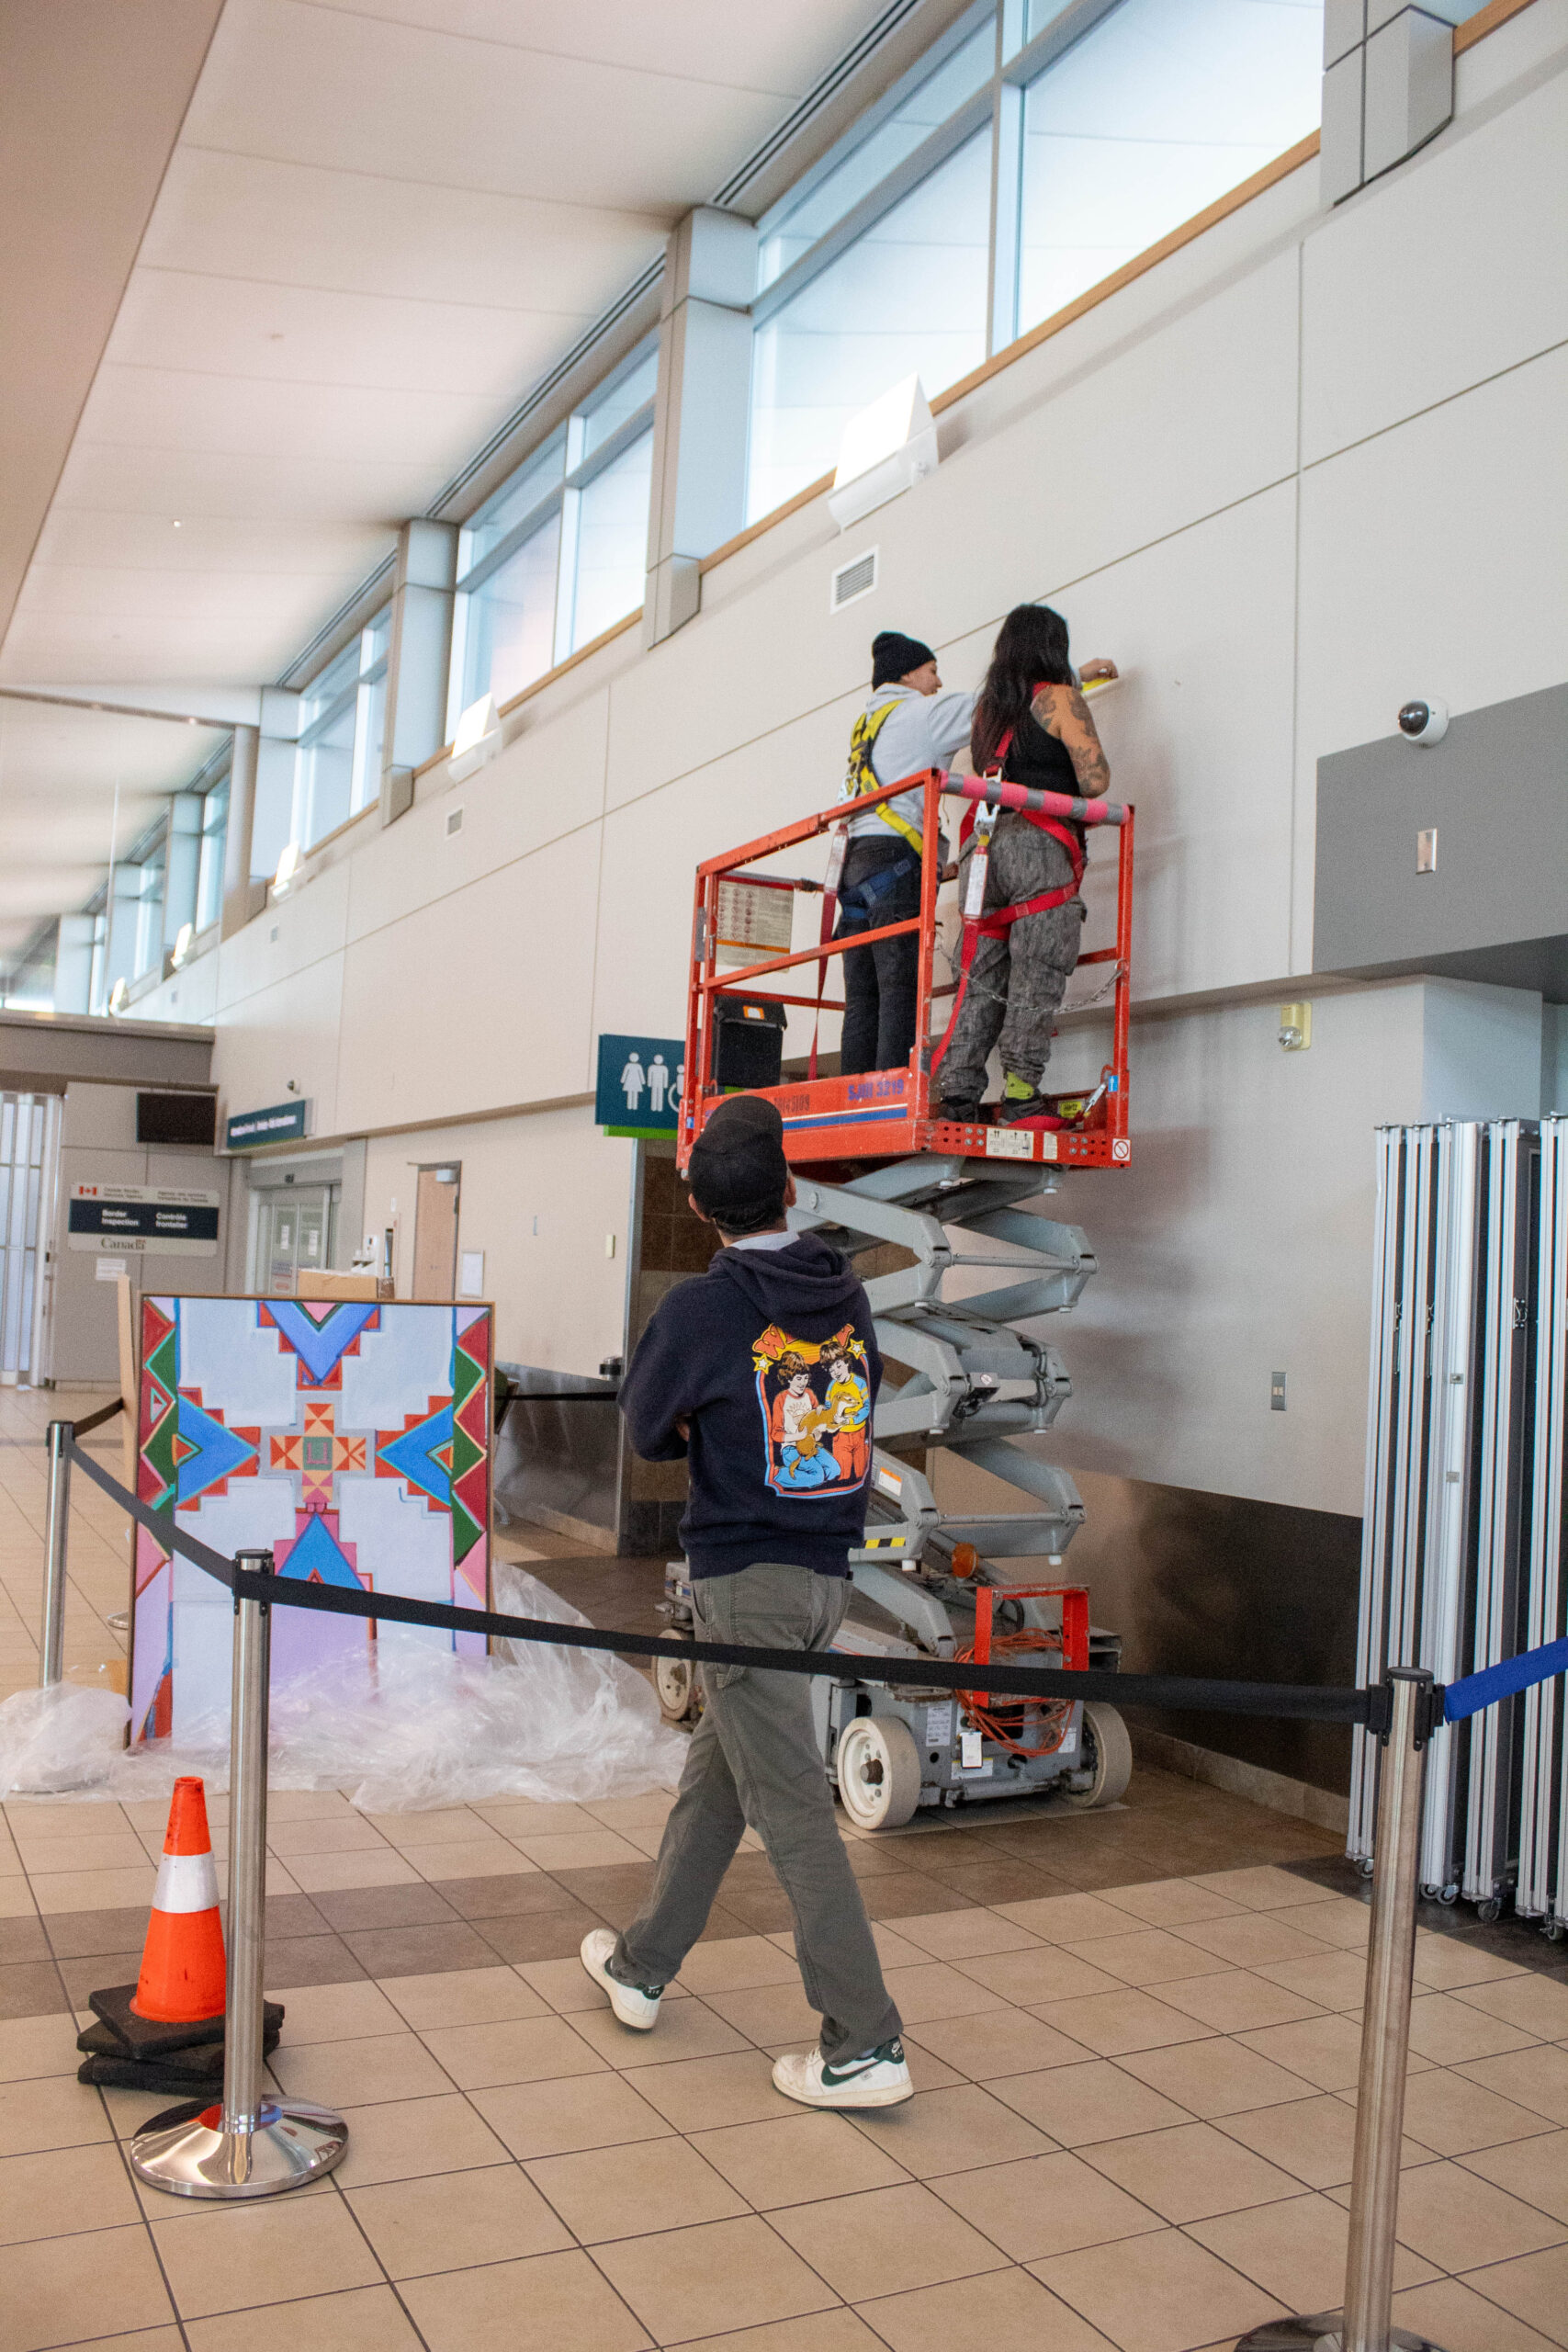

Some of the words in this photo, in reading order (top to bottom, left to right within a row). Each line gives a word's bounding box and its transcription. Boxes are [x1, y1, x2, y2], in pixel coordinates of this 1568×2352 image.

[876, 1079, 904, 1097] 3219
[102, 1209, 127, 1217] Border
[156, 1212, 186, 1221] Contrôle
[102, 1217, 139, 1227] Inspection
[156, 1221, 187, 1229] frontalier
[101, 1237, 145, 1250] Canada
